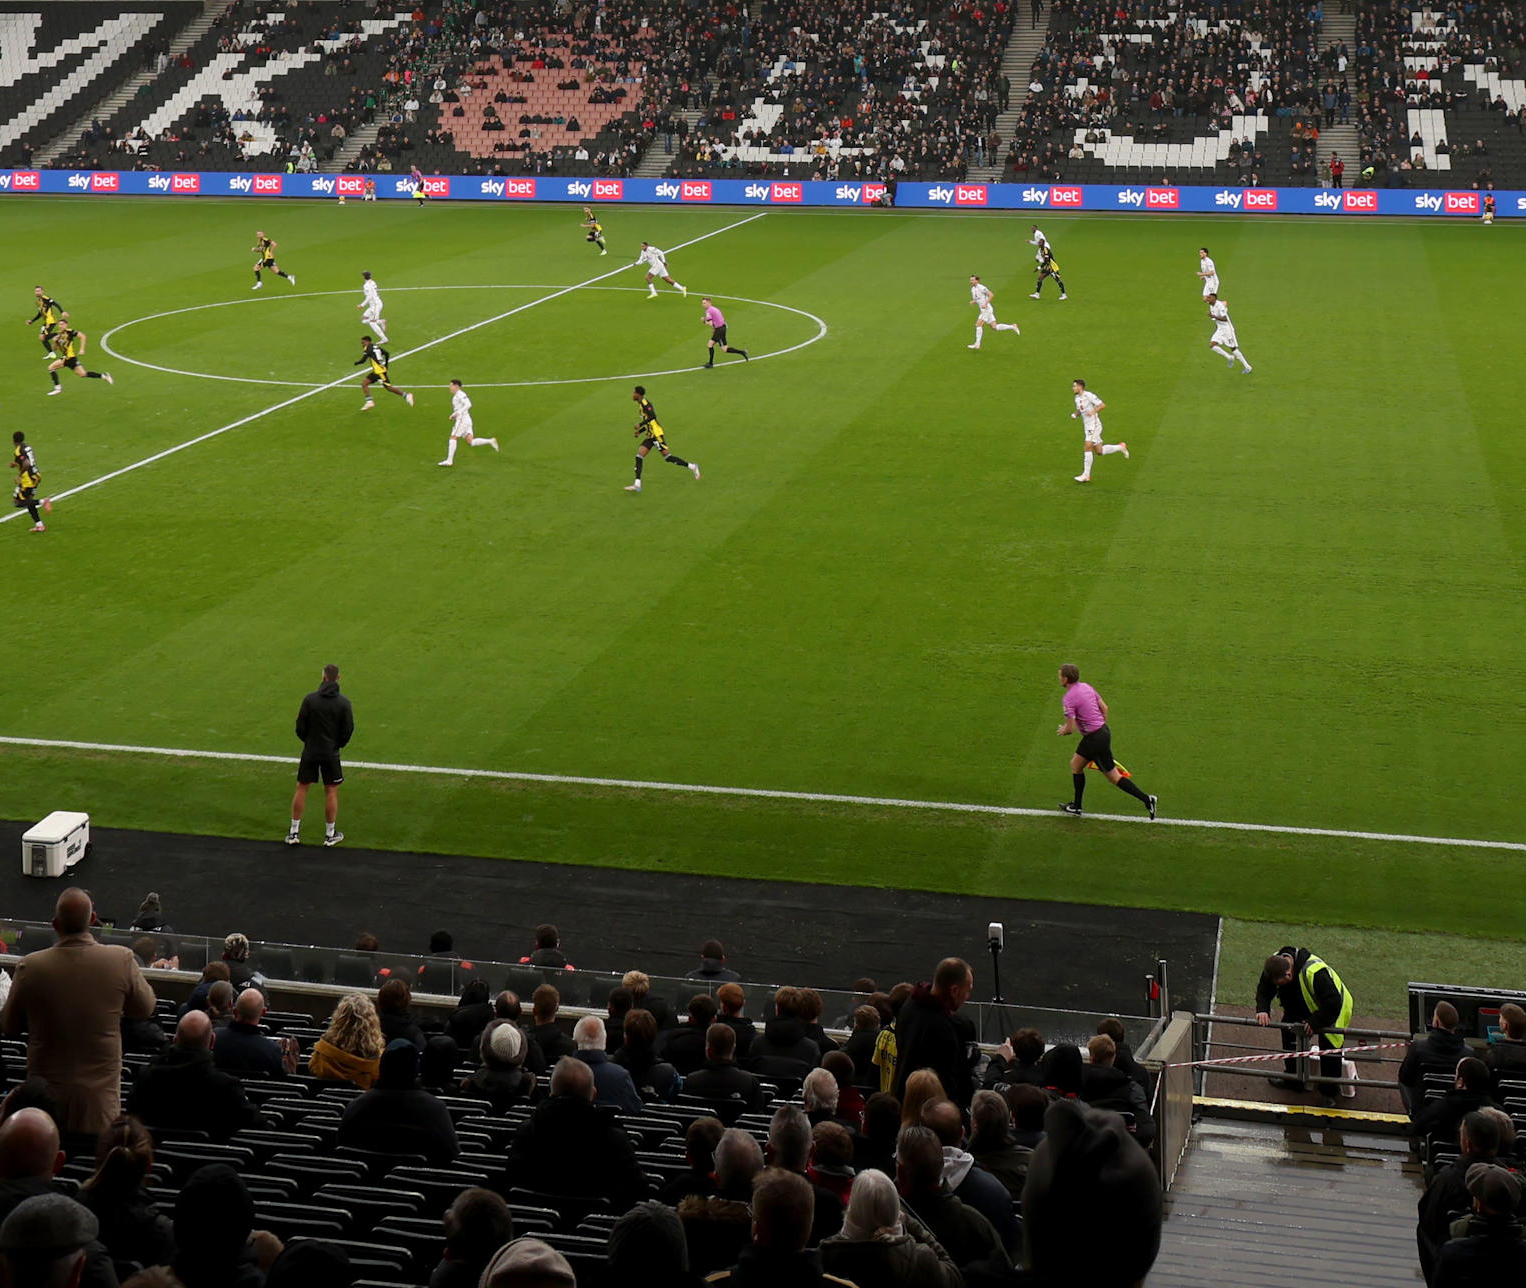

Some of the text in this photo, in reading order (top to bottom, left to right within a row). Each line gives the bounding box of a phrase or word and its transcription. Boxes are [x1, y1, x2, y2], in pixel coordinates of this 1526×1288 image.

[15, 173, 36, 185] bet
[69, 174, 116, 189] sky bet
[148, 175, 197, 191] sky bet
[230, 176, 278, 192] sky bet
[312, 177, 362, 193] sky bet
[481, 179, 532, 196] sky bet
[568, 181, 619, 198] sky bet
[656, 182, 708, 199] sky bet
[745, 184, 799, 200] sky bet
[929, 186, 984, 203] sky bet
[1023, 187, 1079, 205] sky bet
[1118, 189, 1175, 206] sky bet
[1215, 190, 1273, 208] sky bet
[1314, 192, 1374, 210] sky bet
[1415, 193, 1474, 211] sky bet
